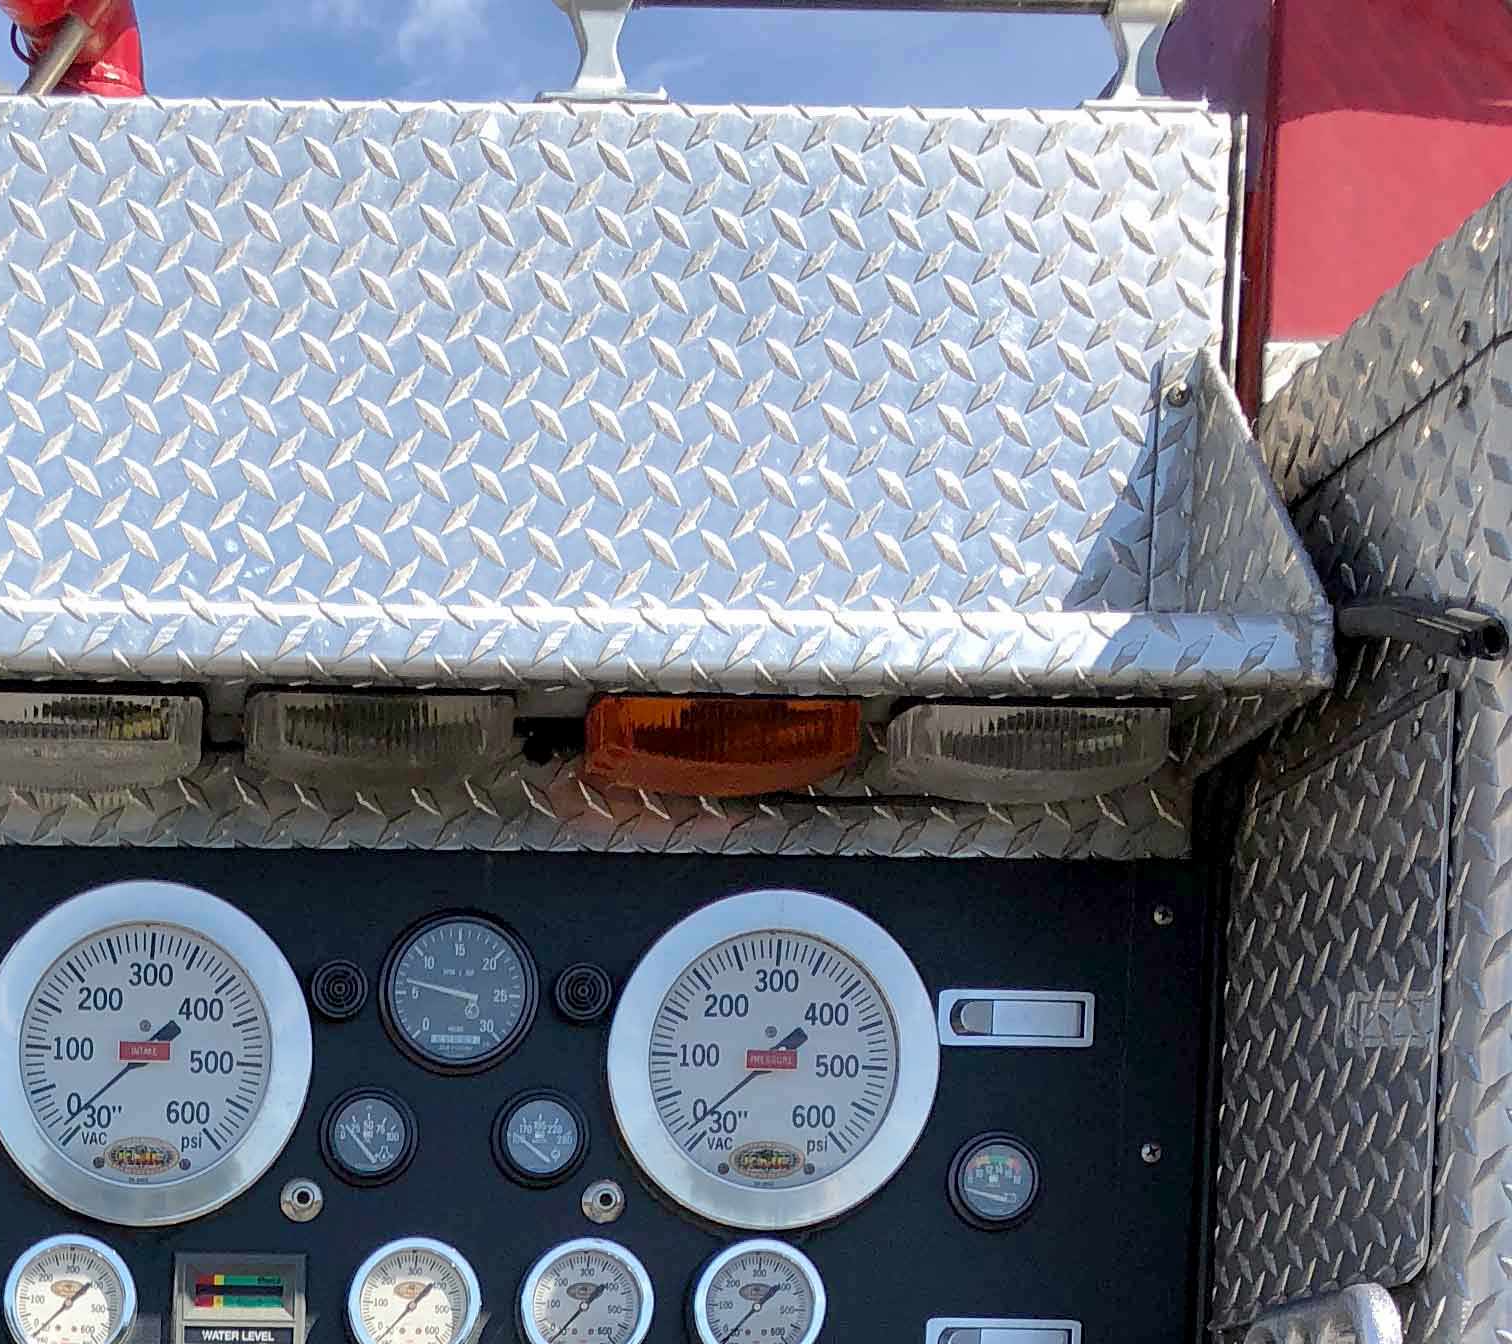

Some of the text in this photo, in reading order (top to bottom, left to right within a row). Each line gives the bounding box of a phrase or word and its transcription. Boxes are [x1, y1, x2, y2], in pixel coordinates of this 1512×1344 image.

[455, 943, 466, 956] 15
[424, 956, 435, 969] 10
[482, 958, 497, 970] 20
[128, 964, 174, 986] 300
[755, 969, 799, 992] 300
[78, 990, 123, 1011] 200
[493, 989, 508, 1002] 25
[703, 995, 749, 1018] 200
[177, 998, 225, 1021] 400
[804, 1002, 850, 1026] 400
[480, 1020, 494, 1033] 30
[53, 1038, 94, 1060] 100
[130, 1046, 159, 1056] INTAKE
[678, 1044, 720, 1068] 100
[189, 1052, 234, 1074] 500
[814, 1055, 859, 1078] 500
[66, 1094, 82, 1116] 0
[166, 1102, 210, 1124] 600
[692, 1101, 708, 1124] 0
[791, 1105, 836, 1128] 600
[81, 1132, 108, 1146] VAC
[180, 1133, 203, 1152] psi
[706, 1135, 733, 1151] VAC
[805, 1136, 829, 1154] psi
[202, 1328, 275, 1344] WATER LEVEL
